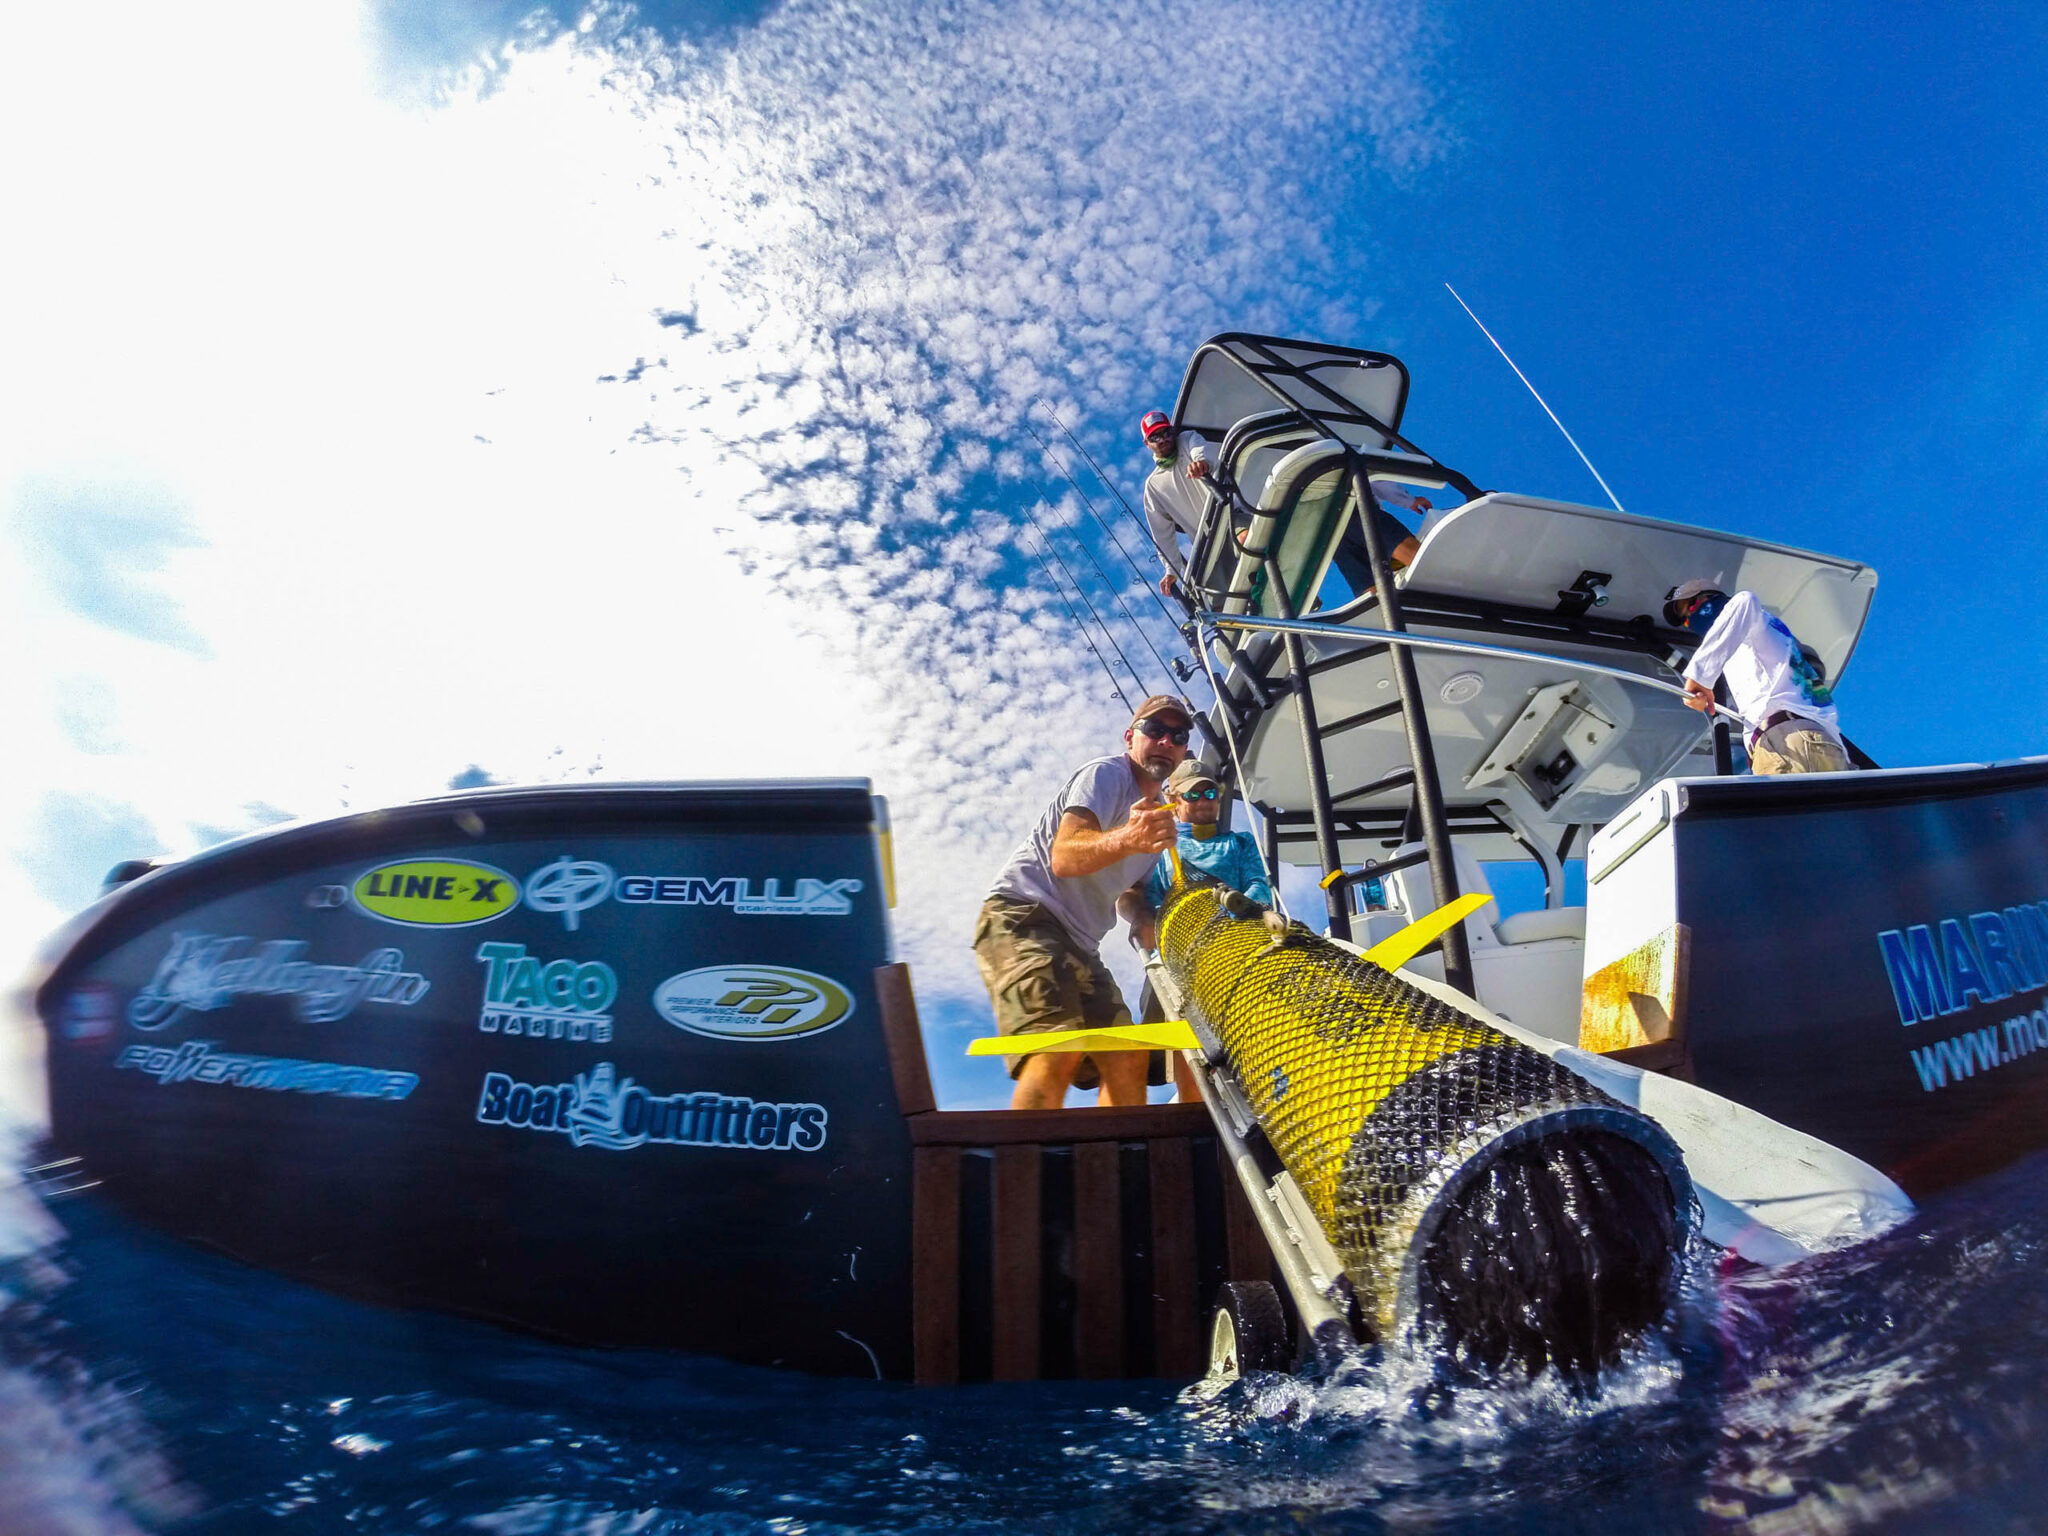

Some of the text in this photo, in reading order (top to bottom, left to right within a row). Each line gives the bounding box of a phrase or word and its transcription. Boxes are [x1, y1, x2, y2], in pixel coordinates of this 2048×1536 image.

[368, 874, 503, 902] LINE-X
[614, 876, 853, 906] GEMLUX
[478, 942, 616, 1012] TACO
[480, 1013, 613, 1043] MARINE
[1909, 996, 2048, 1092] www.mo
[480, 1073, 827, 1149] Boat Outfitters
